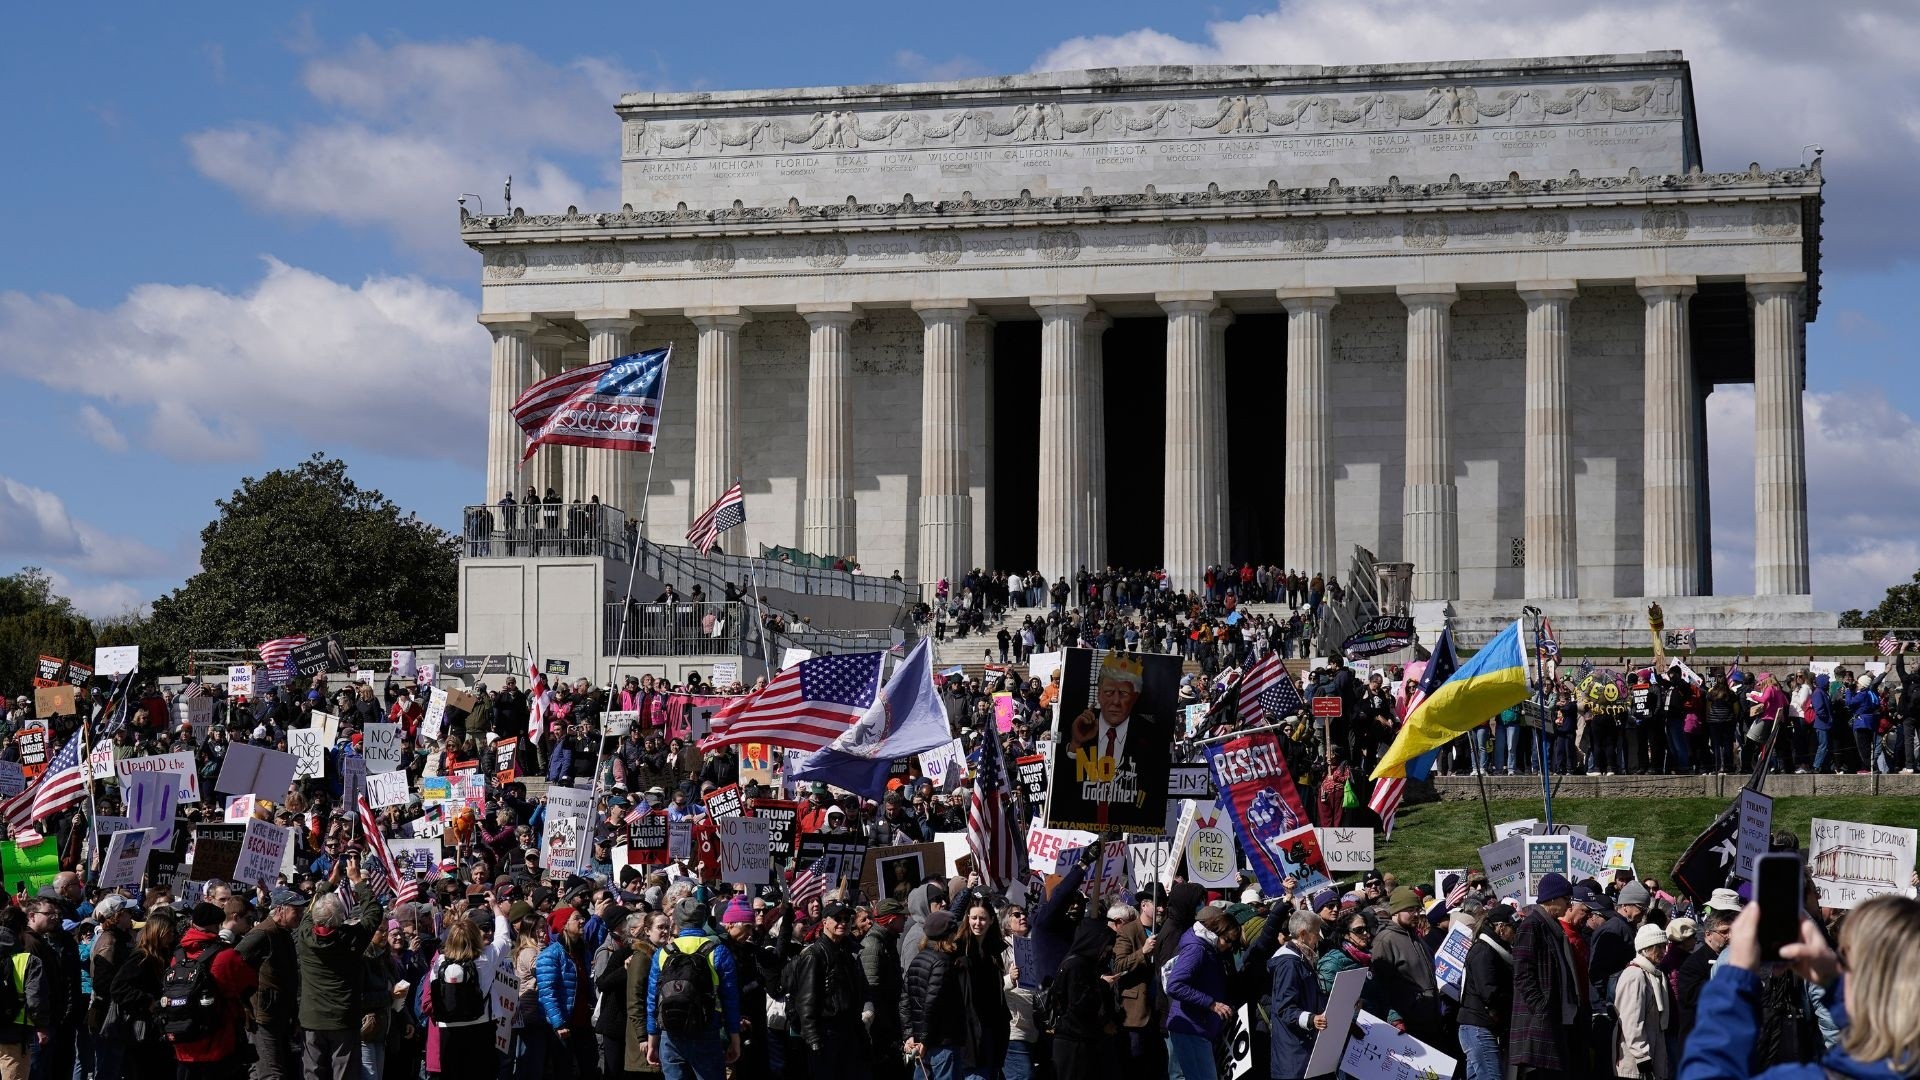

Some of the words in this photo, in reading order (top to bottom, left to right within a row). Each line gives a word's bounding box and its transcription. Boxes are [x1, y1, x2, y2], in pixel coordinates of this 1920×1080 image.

[1422, 131, 1479, 143] NEBRASKA
[1492, 129, 1557, 140] COLORADO
[1567, 126, 1609, 138] NORTH
[1271, 139, 1301, 149] WEST
[1305, 137, 1354, 148] VIRGINIA
[1367, 134, 1410, 145] NEVADA
[1082, 145, 1146, 156] MINNESOTA
[1159, 143, 1206, 153] OREGON
[1217, 141, 1260, 152] KANSAS
[883, 154, 913, 164] IOWA
[927, 150, 993, 161] WISCONSIN
[1004, 147, 1069, 159] CALIFORNIA
[708, 158, 764, 170] MICHIGAN
[774, 157, 820, 168] FLORIDA
[834, 155, 868, 166] TEXAS
[641, 161, 698, 174] ARKANSAS
[40, 659, 62, 670] TRUMP
[40, 665, 59, 675] MUST
[69, 665, 92, 676] TRUMP
[300, 660, 330, 676] VOTE!
[43, 672, 53, 680] GO
[69, 672, 88, 682] MUST
[235, 667, 246, 675] NO
[37, 679, 56, 687] NOW!
[231, 674, 251, 683] KINGS
[1633, 688, 1649, 697] TRUMP
[1634, 696, 1647, 704] MUST
[34, 732, 42, 742] SE
[295, 732, 316, 746] NO
[371, 730, 392, 744] NO
[21, 742, 44, 753] LARGUE
[290, 745, 322, 758] KINGS
[497, 743, 516, 754] TRUMP
[23, 753, 45, 764] TRUMP
[364, 748, 401, 762] KINGS
[30, 765, 42, 774] YA!
[120, 757, 166, 776] UPHOLD
[170, 758, 185, 770] the
[500, 762, 509, 770] GO
[1020, 763, 1044, 775] TRUMP
[1213, 743, 1283, 787] RESIST!
[1023, 773, 1043, 785] MUST
[367, 780, 386, 807] NO
[383, 770, 406, 784] KINGS
[387, 780, 405, 792] ICE
[1030, 784, 1041, 792] GO
[386, 792, 407, 803] WAR
[549, 796, 573, 808] HITLER
[576, 799, 597, 809] WOUD
[709, 791, 728, 808] ¡QUE
[727, 789, 739, 801] SE
[1029, 791, 1047, 803] NOW!
[710, 800, 742, 818] LARGUE
[755, 807, 796, 820] TRUMP
[653, 815, 666, 826] SE
[769, 821, 791, 831] UST
[630, 826, 667, 838] LARGUE
[721, 819, 737, 836] NO
[742, 821, 767, 835] TRUMP
[268, 827, 284, 843] HERE
[769, 831, 783, 842] GO
[1199, 832, 1223, 844] PEDO
[1872, 829, 1906, 847] Drama
[247, 836, 280, 858] BECAUSE
[632, 837, 665, 848] TRUMP
[768, 842, 790, 853] OW!
[552, 848, 576, 858] PROTECT
[742, 842, 768, 856] GESTAPO
[1199, 846, 1224, 859] PREZ
[412, 853, 435, 862] YES
[641, 850, 657, 862] YA!
[721, 841, 741, 873] NO
[1133, 846, 1168, 871] NO
[1327, 850, 1344, 863] NO
[1347, 850, 1373, 864] KINGS
[249, 854, 260, 869] WE
[259, 857, 276, 873] LOVE
[551, 858, 576, 868] FREEDOM
[1490, 863, 1503, 873] WHY
[1504, 855, 1521, 868] WAR?
[243, 866, 257, 880] OUR
[1494, 874, 1516, 889] TRUMP
[494, 969, 519, 990] KINGS
